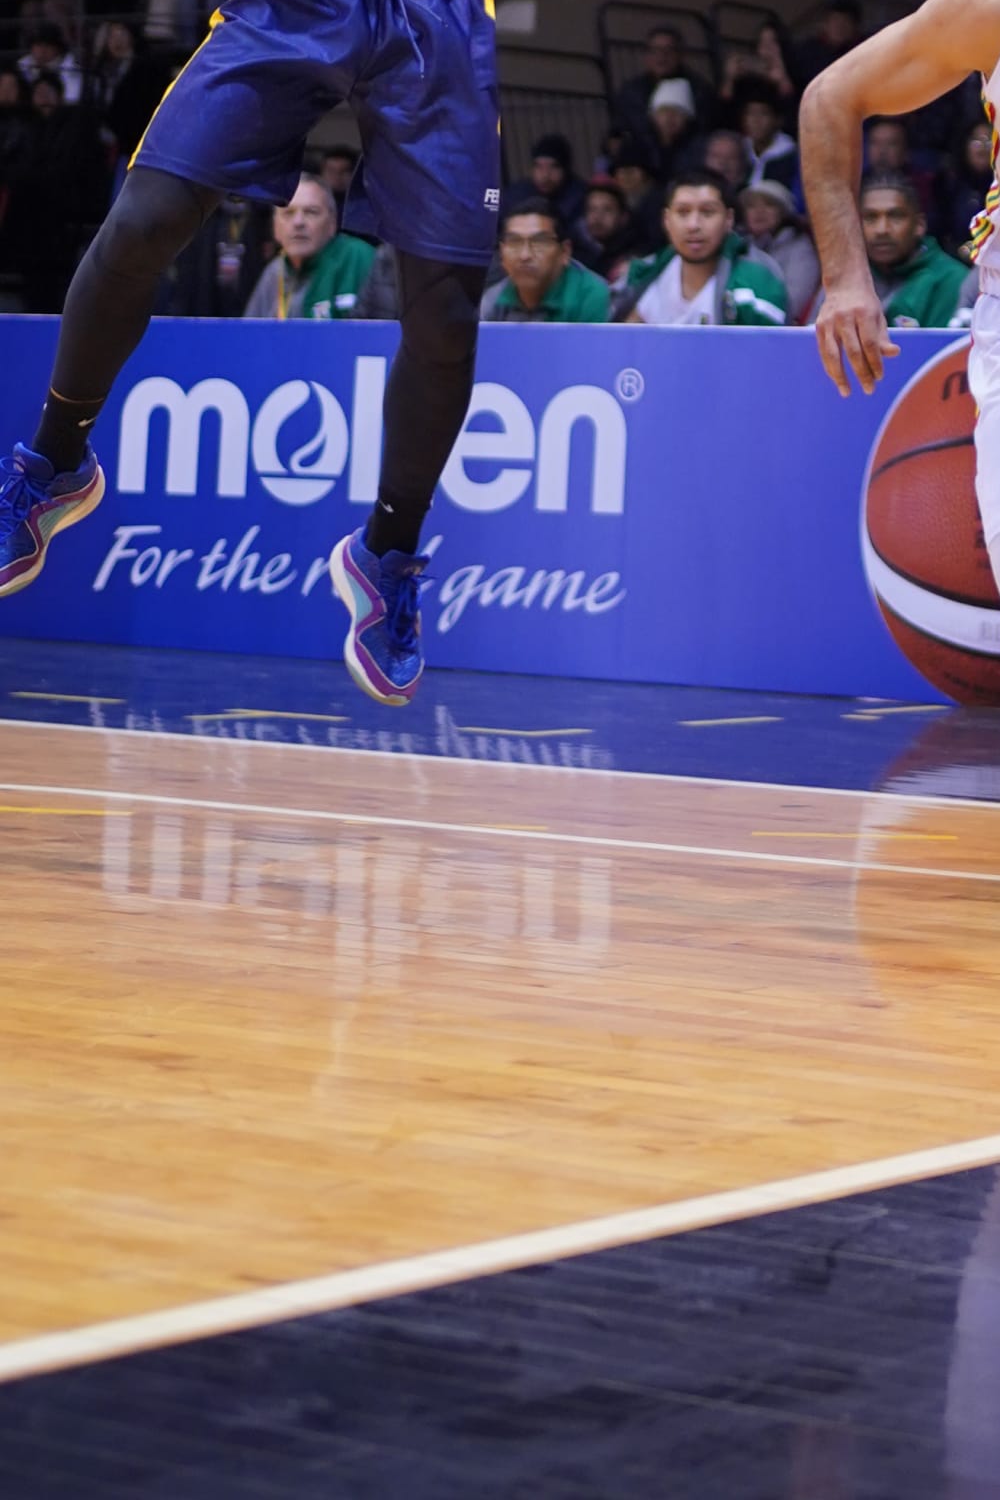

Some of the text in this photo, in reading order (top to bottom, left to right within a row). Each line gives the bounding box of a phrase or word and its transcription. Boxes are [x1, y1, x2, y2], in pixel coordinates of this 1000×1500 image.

[116, 355, 627, 514] molen
[93, 524, 193, 591] For
[197, 525, 297, 594] the
[438, 564, 625, 634] game
